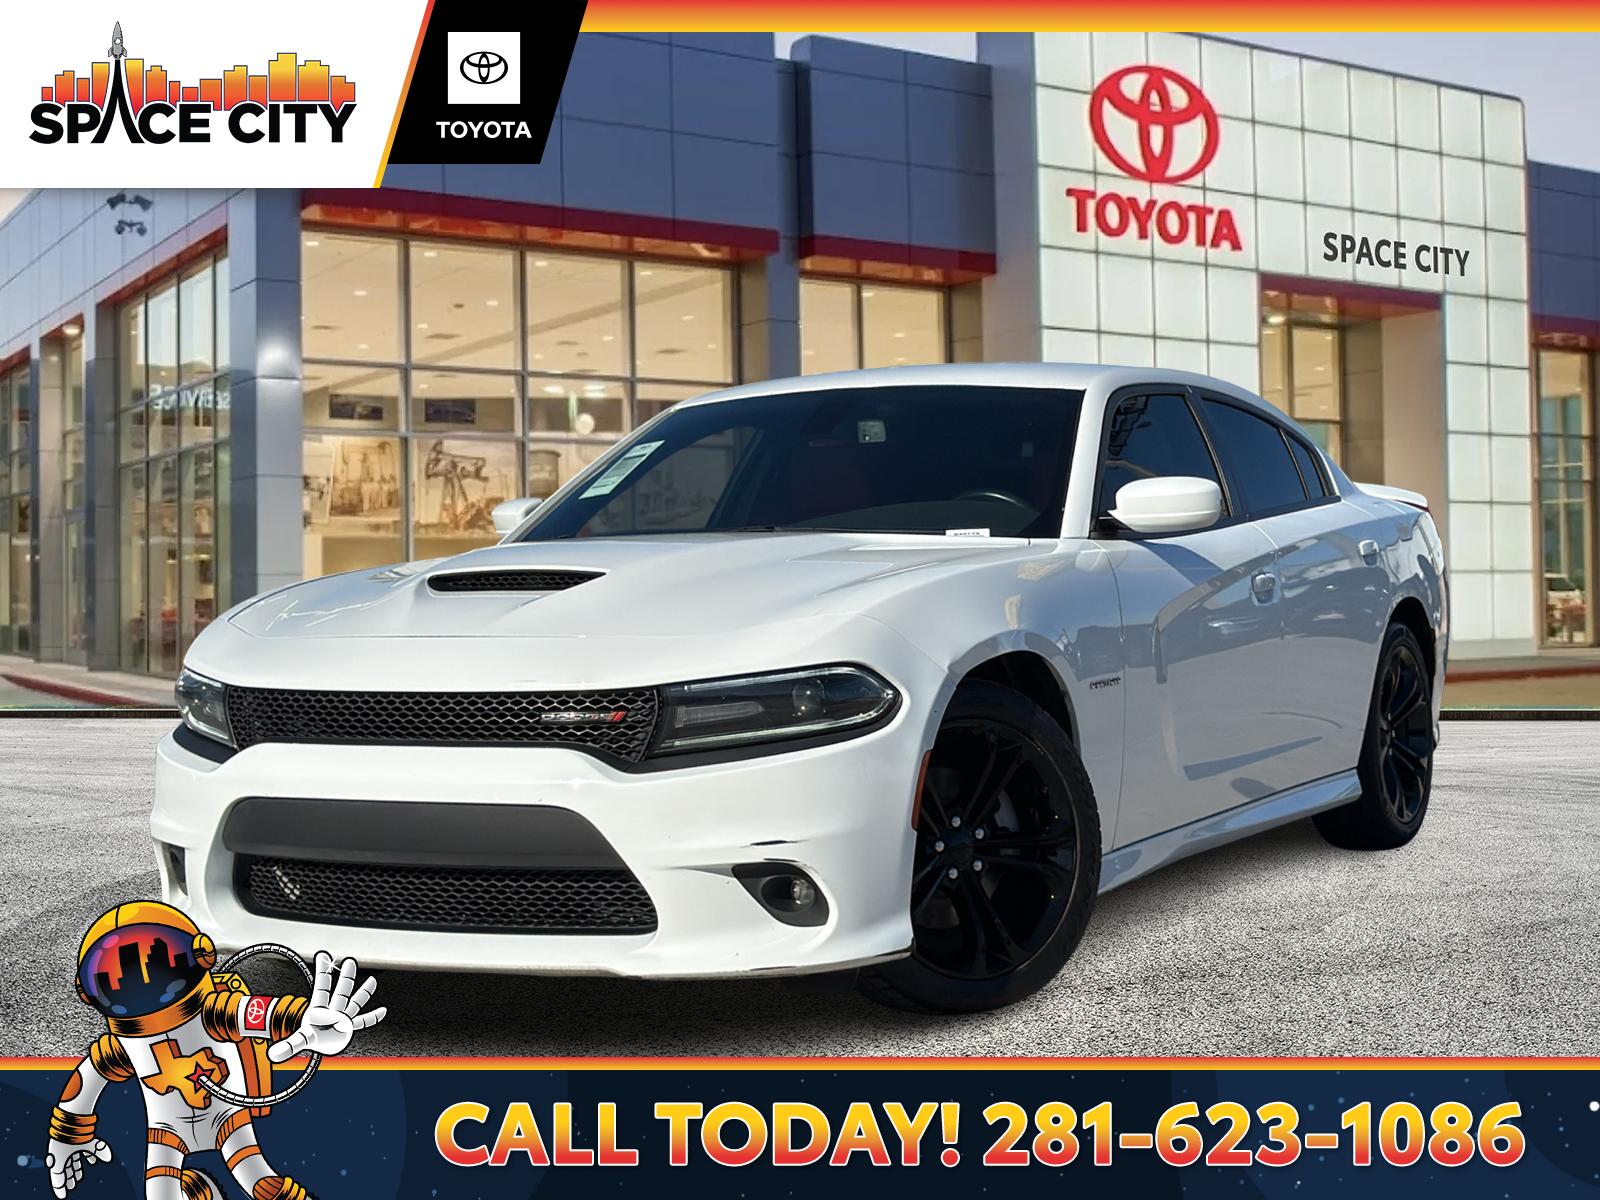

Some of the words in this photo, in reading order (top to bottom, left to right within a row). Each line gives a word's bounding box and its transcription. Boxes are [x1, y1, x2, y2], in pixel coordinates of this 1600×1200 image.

[1066, 187, 1243, 252] TOYOTA
[1322, 231, 1407, 271] SPACE
[1413, 244, 1471, 277] CITY
